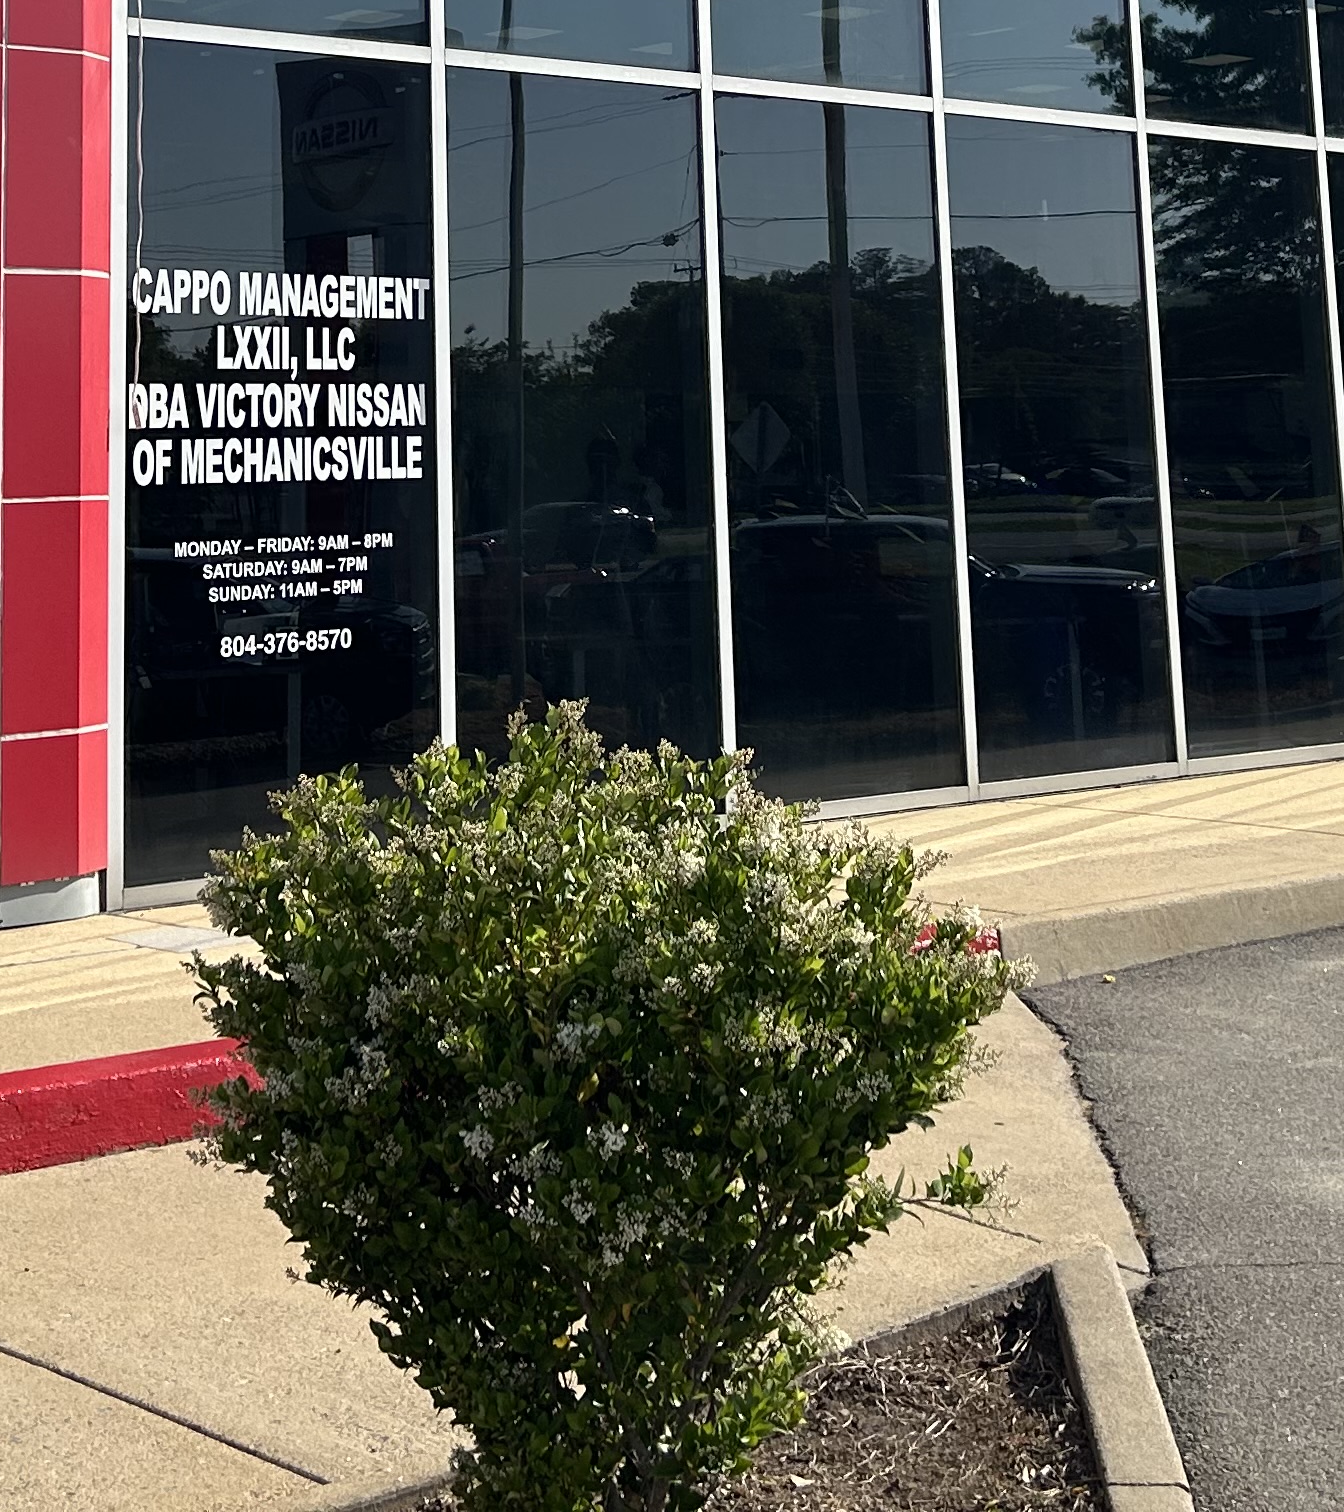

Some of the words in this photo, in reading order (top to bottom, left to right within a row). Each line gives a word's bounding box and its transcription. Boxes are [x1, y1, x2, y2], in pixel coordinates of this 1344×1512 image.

[133, 268, 231, 316] CAPPO
[239, 272, 429, 321] MANAGEMENT
[217, 325, 299, 380] LXXII,
[306, 327, 355, 371] LLC
[129, 384, 189, 429] DBA
[197, 384, 320, 428] VICTORY
[329, 384, 426, 428] NISSAN
[133, 439, 172, 486] OF
[181, 436, 423, 484] MECHANICSVILLE
[174, 540, 241, 558] MONDAY
[257, 537, 315, 553] FRIDAY:
[318, 534, 349, 551] 9AM
[364, 533, 393, 548] 8PM
[203, 561, 288, 579] SATURDAY:
[291, 558, 323, 574] 9AM
[338, 557, 368, 572] 7PM
[209, 584, 275, 602] SUNDAY:
[279, 582, 318, 598] 11AM
[333, 579, 363, 596] 5PM
[220, 628, 352, 657] 804-376-8570
